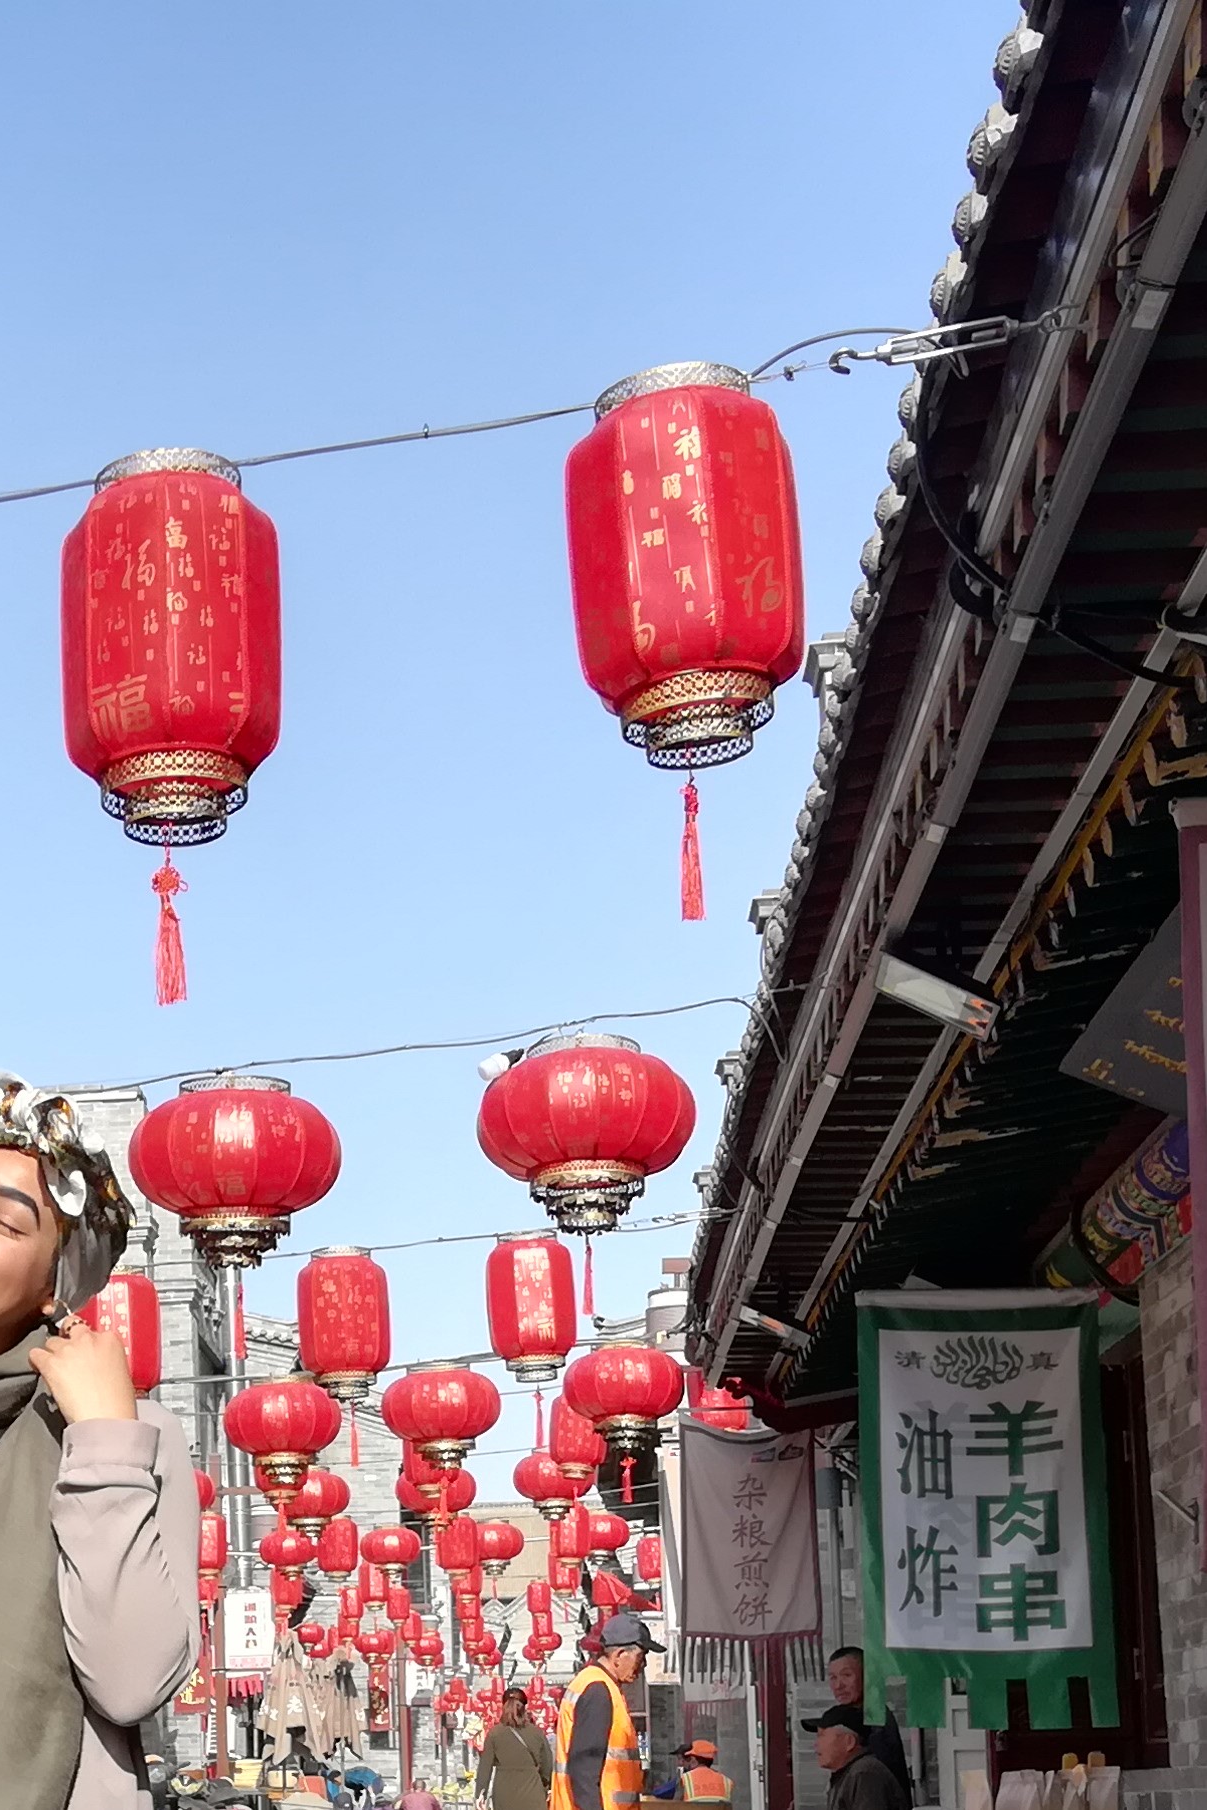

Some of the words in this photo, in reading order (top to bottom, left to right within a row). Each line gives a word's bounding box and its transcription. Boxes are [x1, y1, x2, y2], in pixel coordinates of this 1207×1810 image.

[122, 539, 157, 591] 福
[92, 673, 153, 742] 福
[895, 1350, 926, 1369] 清
[1026, 1351, 1059, 1370] 真
[732, 1473, 773, 1630] 杂粮煎饼
[896, 1409, 958, 1617] 油炸
[966, 1400, 1067, 1641] 羊肉串
